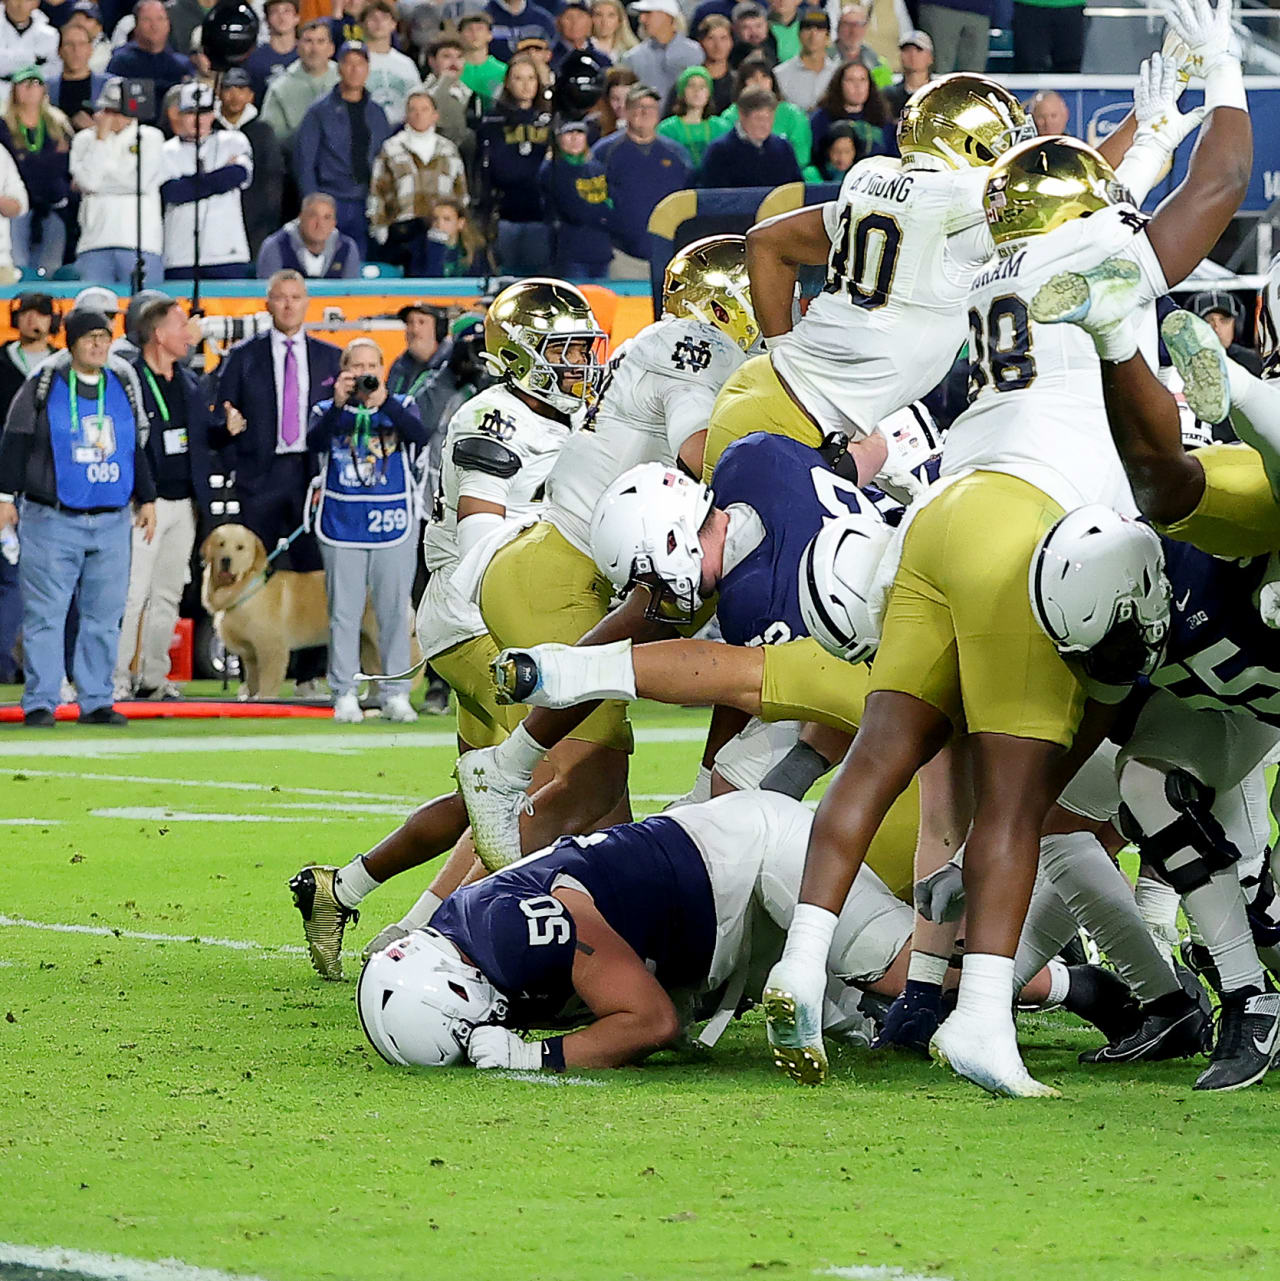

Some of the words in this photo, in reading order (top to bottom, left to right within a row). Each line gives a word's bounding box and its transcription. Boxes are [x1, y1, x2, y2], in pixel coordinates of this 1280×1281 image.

[86, 462, 120, 483] 089
[367, 508, 407, 533] 259
[518, 895, 571, 946] 50
